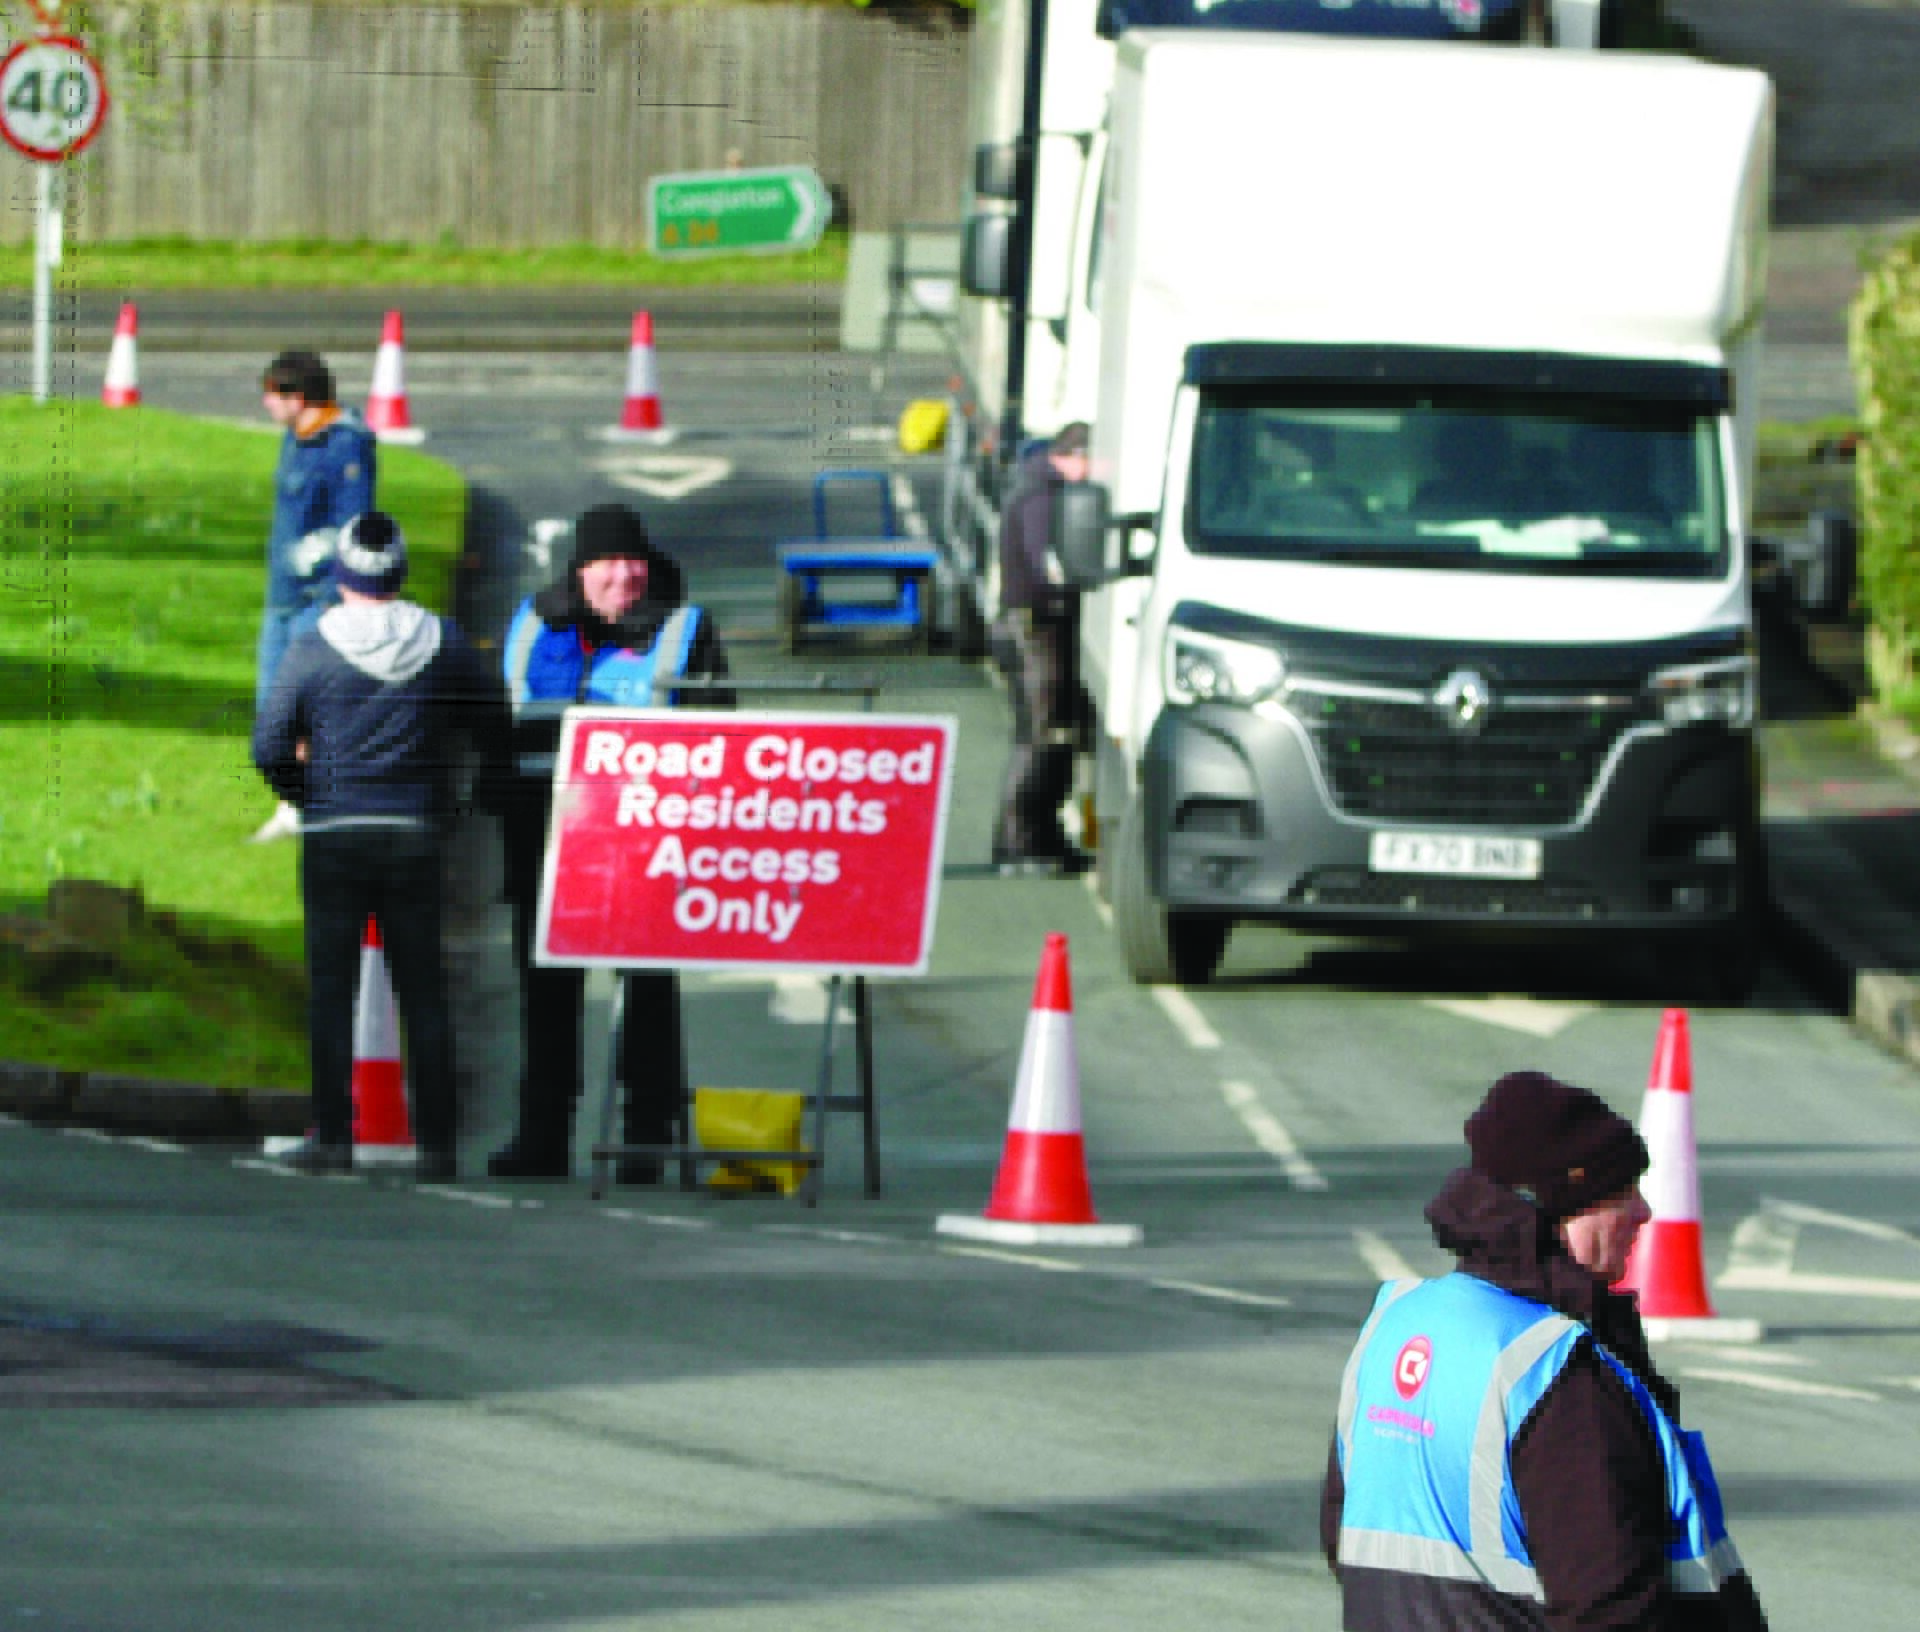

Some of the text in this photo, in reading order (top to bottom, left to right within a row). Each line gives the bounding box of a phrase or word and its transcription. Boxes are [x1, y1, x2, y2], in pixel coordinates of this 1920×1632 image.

[8, 70, 89, 121] 40
[584, 730, 936, 784] Road Closed
[616, 783, 888, 835] Residents
[645, 835, 841, 884] Access
[673, 887, 804, 943] Only
